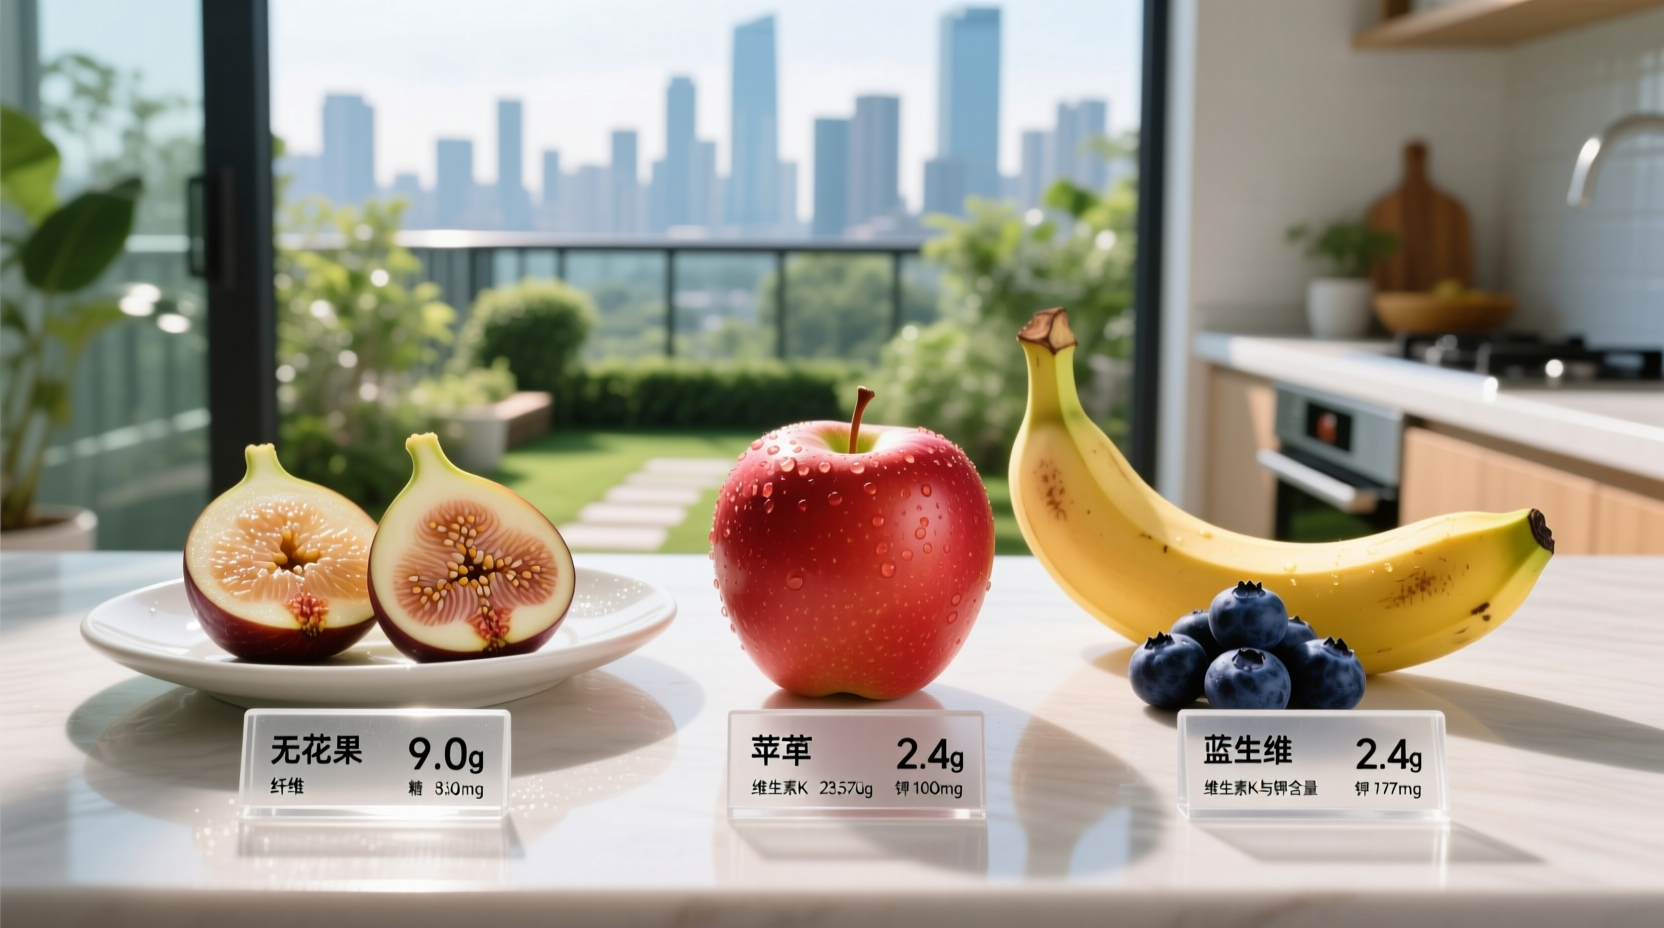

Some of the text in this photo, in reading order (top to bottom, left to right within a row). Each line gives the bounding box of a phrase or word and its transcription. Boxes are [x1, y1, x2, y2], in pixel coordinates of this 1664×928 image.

[270, 733, 484, 774] 无花果 9.0g
[896, 737, 964, 773] 2.4g
[1204, 734, 1422, 773] 蓝生维 2.4g
[270, 777, 305, 795] 纤维
[751, 779, 809, 796] 维生素K
[913, 780, 963, 799] 100mg
[1374, 781, 1422, 799] 177mg
